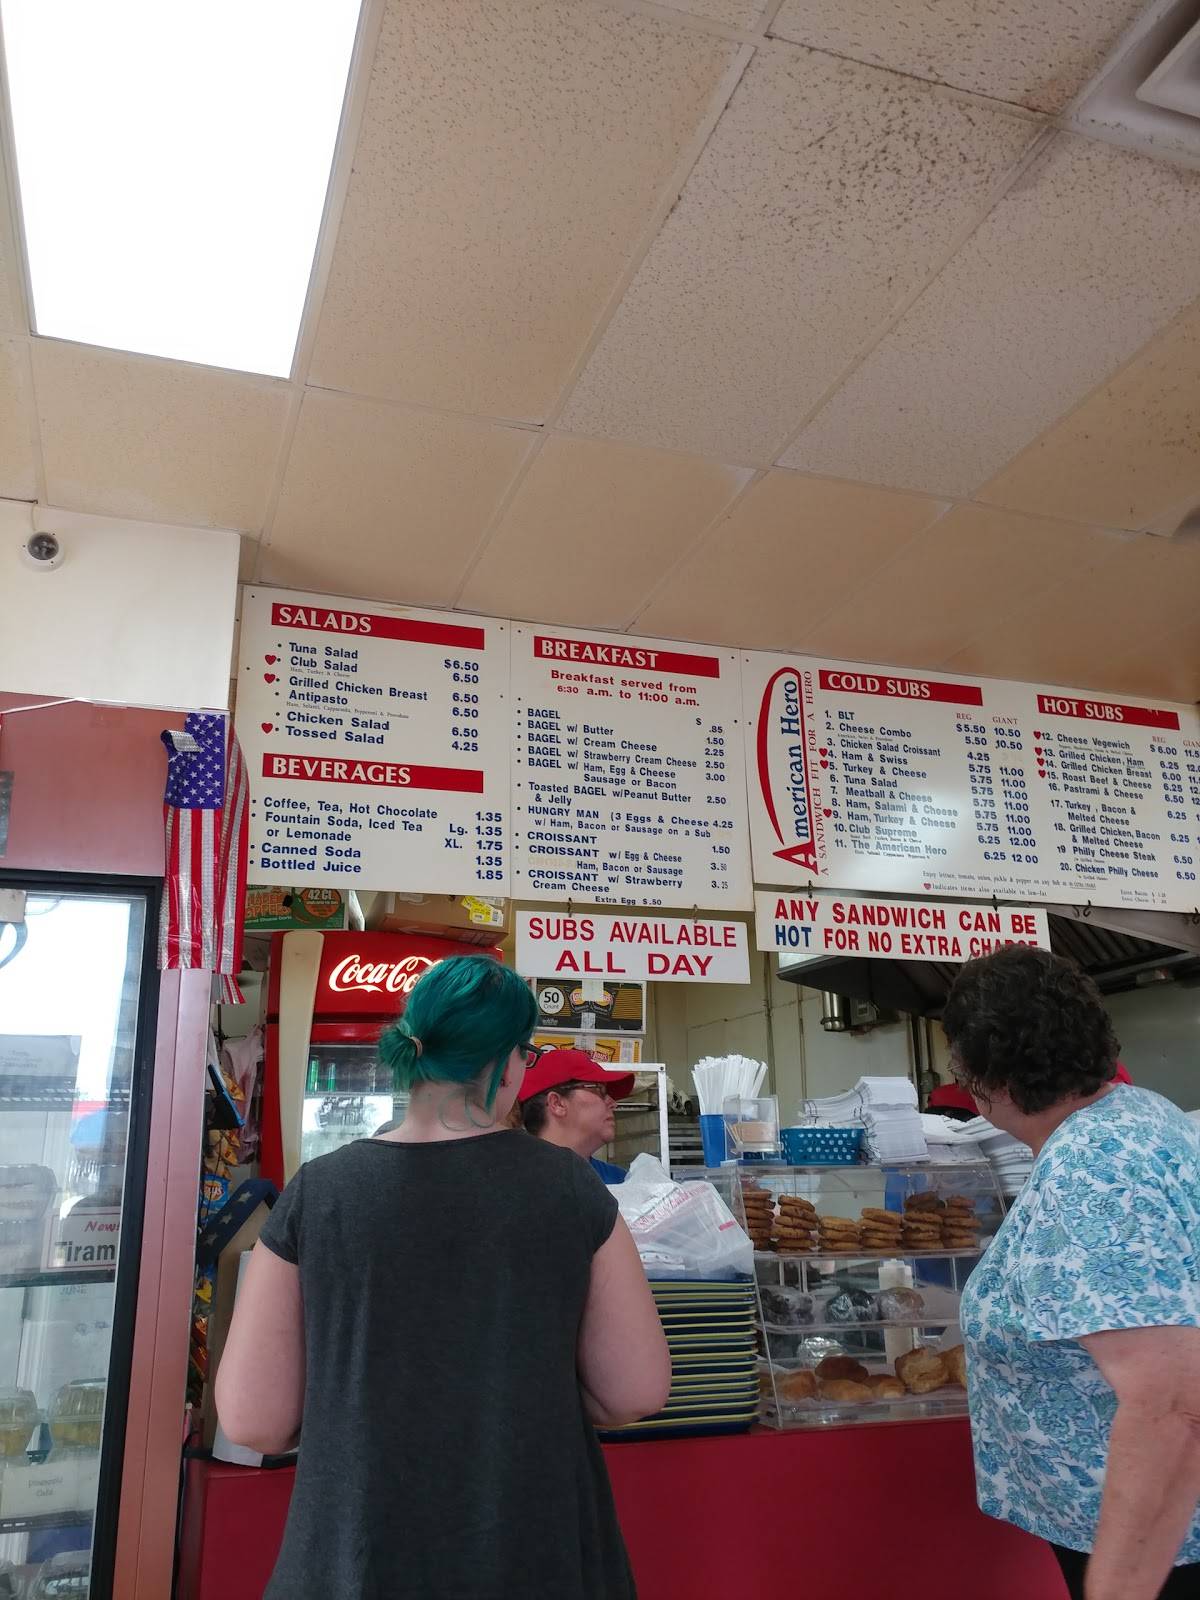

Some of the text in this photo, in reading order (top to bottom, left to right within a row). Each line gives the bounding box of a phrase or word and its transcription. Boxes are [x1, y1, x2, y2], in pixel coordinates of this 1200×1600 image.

[279, 607, 372, 633] SALADS
[289, 642, 479, 672] Tuna Salad $6.50
[541, 639, 659, 669] BREAKFAST
[291, 656, 318, 670] Club
[324, 660, 358, 673] Salad
[452, 673, 479, 684] 6.50
[551, 669, 697, 694] Breakfast served from
[289, 676, 479, 704] Grilled Chicken Breast 6.50
[557, 685, 700, 707] 6:30 a.m. to 11:00 a.m.
[828, 673, 931, 698] COLD SUBS
[289, 689, 479, 718] Antipasto 6.50
[781, 680, 800, 735] Hero
[1044, 698, 1124, 721] HOT SUBS
[287, 711, 478, 738] Chicken Salad 6.50
[527, 708, 723, 734] BAGEL $ .85
[824, 709, 1021, 738] 1. BLT $5.50 10.50
[956, 712, 1018, 725] REG GIANT
[285, 725, 479, 752] Tossed Salad 4.25
[527, 720, 724, 746] BAGEL w/ Butter 1.50
[528, 733, 725, 757] BAGEL w/ Cream Cheese 2.25
[528, 746, 725, 770] BAGEL w/ Strawberry Cream Cheese 2.50
[826, 737, 836, 747] 3.
[840, 738, 873, 750] Chicken
[876, 742, 899, 753] Salad
[903, 744, 941, 757] Croissant
[967, 752, 990, 762] 4.25
[272, 757, 411, 785] BEVERAGES
[528, 758, 725, 782] BAGEL w/ Ham, Egg & Cheese 3.00
[584, 774, 626, 786] Sausage
[646, 779, 677, 789] Bacon
[803, 671, 830, 876] A SANDWICH FIT FOR A HERO
[829, 761, 1026, 789] 5. Turkey & Cheese 5.75 11.00
[1061, 761, 1088, 772] Grilled
[1091, 764, 1123, 775] Chicken
[1126, 767, 1152, 779] Breast
[1162, 772, 1181, 782] 6.00
[264, 797, 502, 822] Coffee, Tea, Hot Chocolate 1.35
[265, 812, 502, 837] Fountain Soda, Iced Tea Lg. 1.35
[267, 827, 503, 851] or Lemonade XL. 1.75
[527, 831, 730, 855] CROISSANT 1.50
[261, 842, 502, 867] Canned Soda 1.35
[1073, 846, 1095, 857] Philly
[1100, 849, 1129, 860] Cheese
[1133, 851, 1156, 862] Steak
[1174, 855, 1193, 865] 6.50
[261, 857, 503, 881] Bottled Juice 1.85
[533, 880, 610, 893] Cream Cheese
[595, 896, 617, 904] Extra
[775, 898, 1037, 935] ANY SANDWICH CAN BE
[528, 917, 737, 948] SUBS AVAILABLE
[775, 924, 812, 948] HOT
[824, 928, 859, 950] FOR
[868, 931, 892, 953] NO
[902, 933, 962, 957] EXTRA
[329, 954, 443, 993] Coca-Co
[555, 949, 713, 977] ALL DAY
[544, 992, 559, 1003] 50
